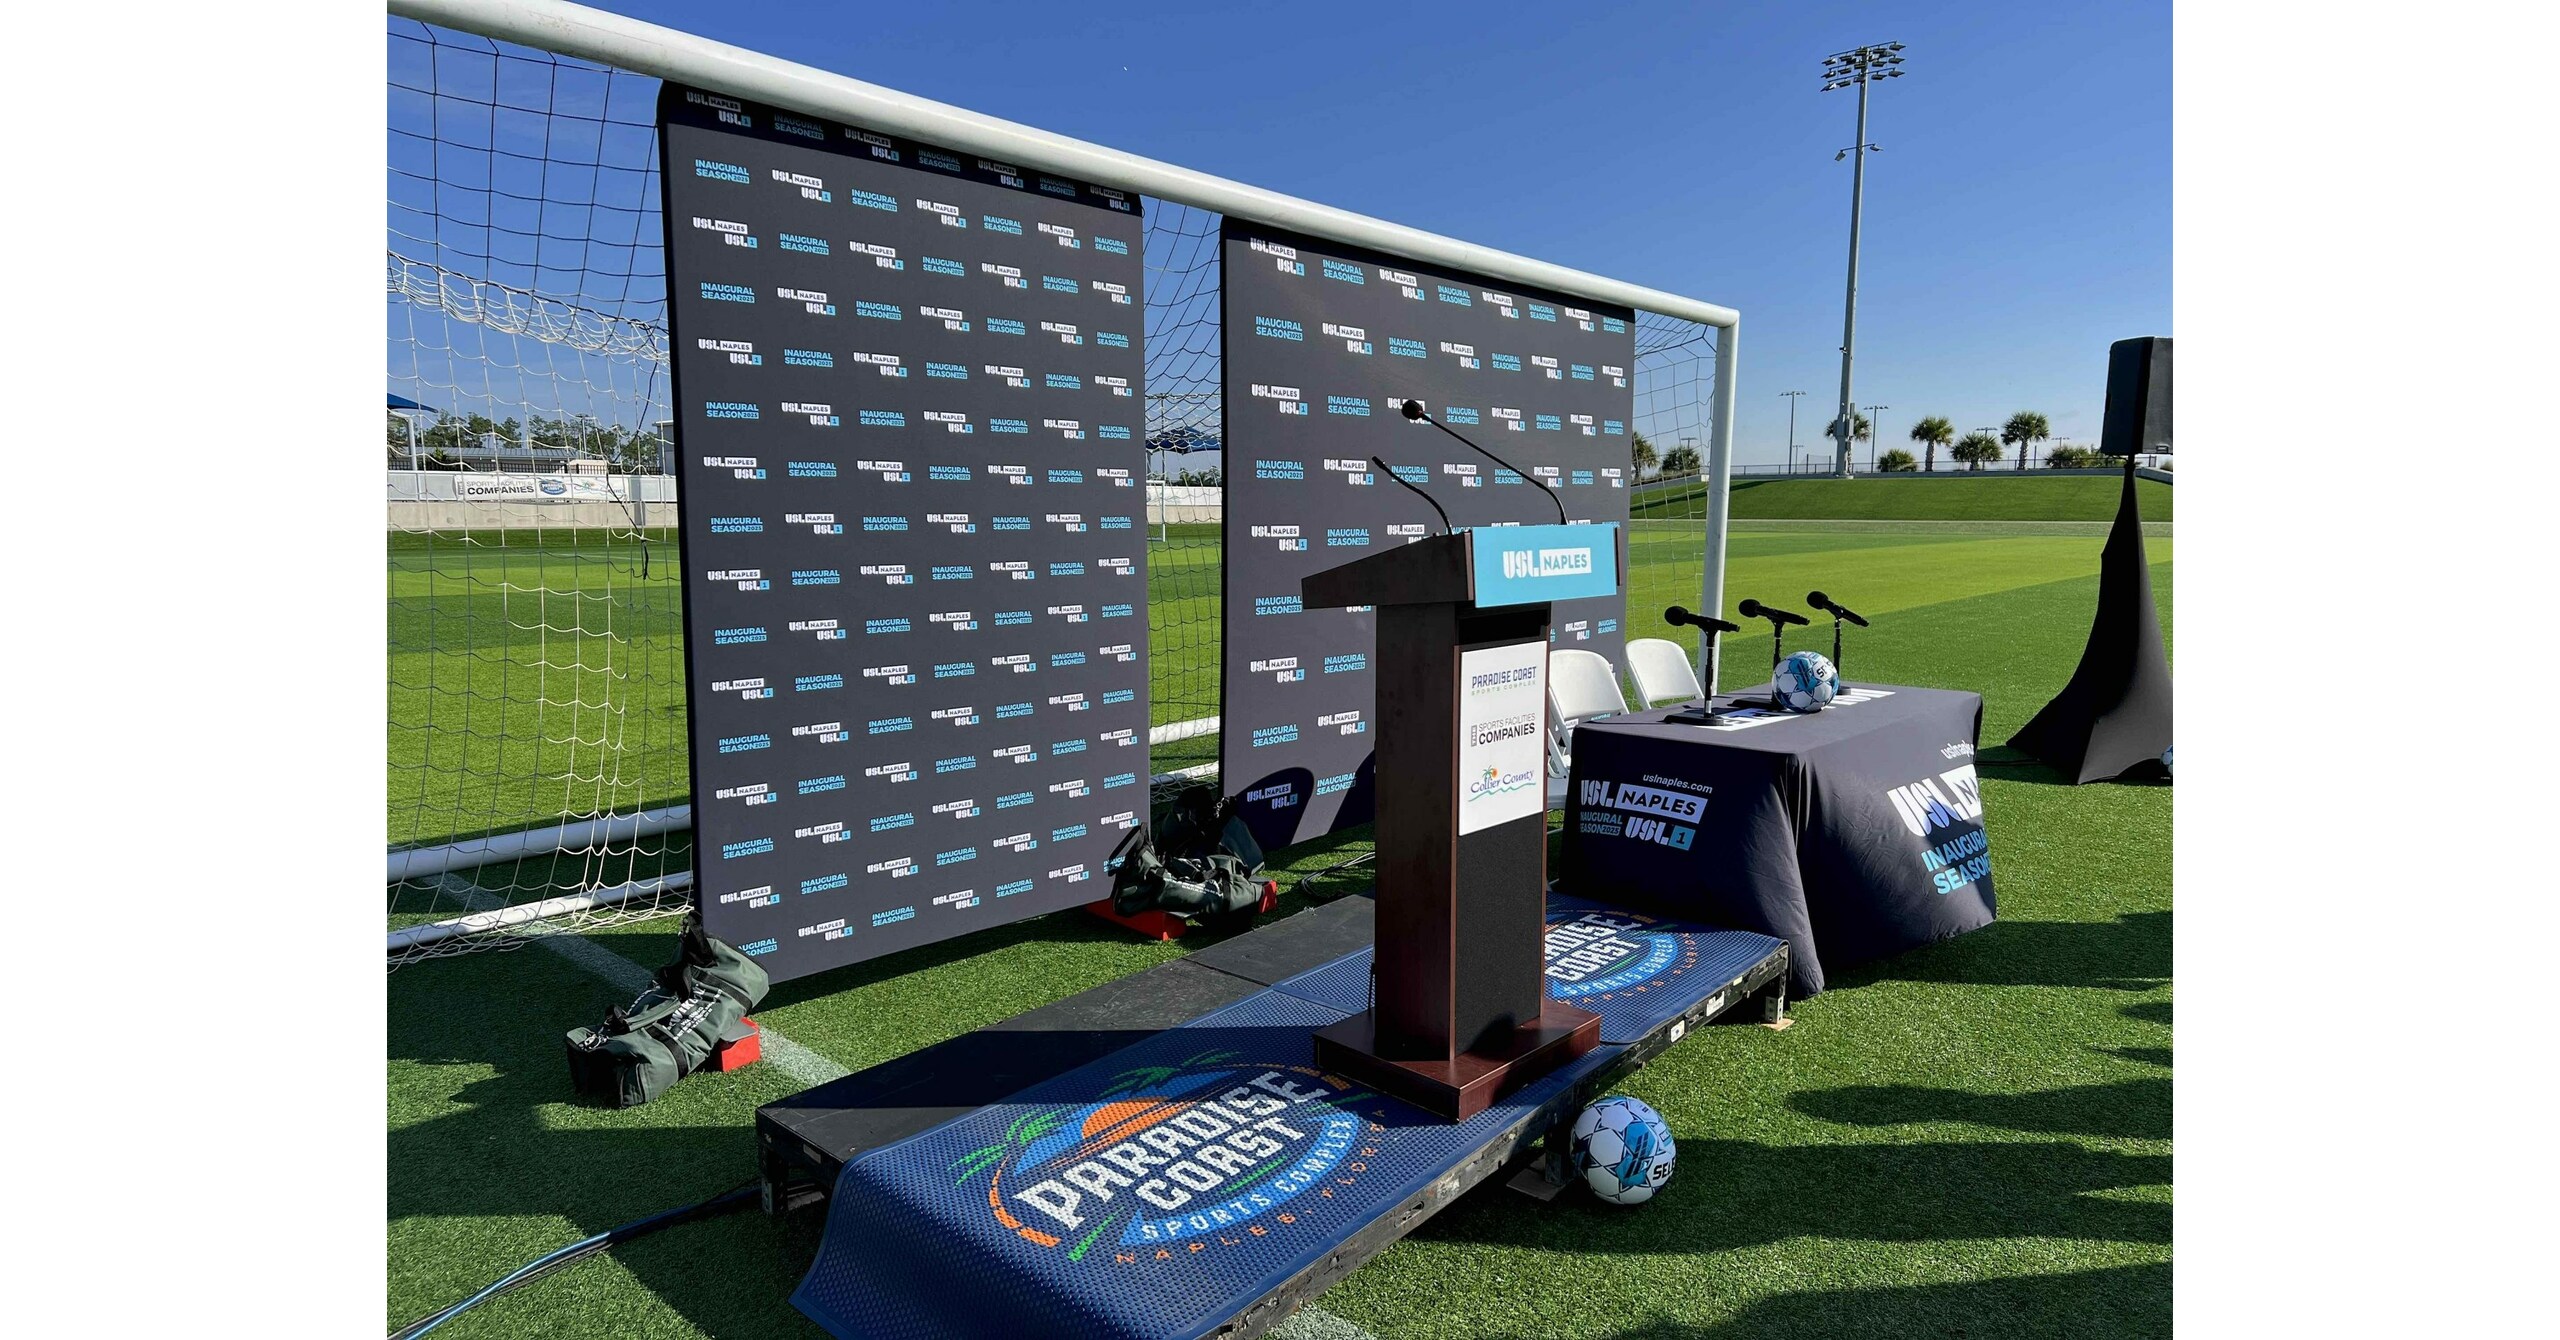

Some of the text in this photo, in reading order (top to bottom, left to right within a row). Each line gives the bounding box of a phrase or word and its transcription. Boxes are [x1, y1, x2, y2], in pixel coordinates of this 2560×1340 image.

[696, 160, 749, 175] INAUGURAL
[794, 176, 820, 187] NAPLES
[717, 222, 746, 233] NAPLES
[780, 233, 829, 247] INAUGURAL
[1271, 245, 1295, 257] NAPLES
[1323, 259, 1363, 276] INAUGURAL
[701, 283, 754, 295] INAUGURAL
[1256, 316, 1302, 331] INAUGURAL
[1341, 328, 1363, 338] NAPLES
[722, 342, 750, 351] NAPLES
[784, 349, 832, 360] INAUGURAL
[1273, 388, 1298, 398] NAPLES
[706, 402, 759, 411] INAUGURAL
[803, 405, 829, 413] NAPLES
[1256, 460, 1303, 470] INAUGURAL
[467, 485, 535, 495] COMPANIES
[1272, 527, 1298, 535] NAPLES
[1503, 550, 1588, 579] USL NAPLES
[792, 570, 840, 578] INAUGURAL
[715, 627, 766, 636] INAUGURAL
[796, 674, 843, 684] INAUGURAL
[1472, 666, 1537, 688] PARADISE COAST
[735, 680, 762, 688] NAPLES
[1479, 713, 1536, 732] SPORTS FACILITIES
[1479, 722, 1535, 745] COMPANIES
[719, 734, 770, 746] INAUGURAL
[798, 775, 845, 787] INAUGURAL
[1470, 769, 1535, 793] Collier County
[1642, 774, 1713, 793] uslnaples.com
[739, 785, 766, 795] NAPLES
[1621, 790, 1697, 816] NAPLES
[1580, 811, 1623, 825] NAUGURAL
[723, 838, 773, 852] INAUGURAL
[1921, 828, 1988, 872] INAUGURA
[743, 887, 769, 898] NAPLES
[1545, 936, 1641, 981] COAST
[1012, 1070, 1331, 1231] PARADISE
[1276, 1119, 1354, 1193] COMPLEX
[1322, 1108, 1386, 1198] FLORIDA
[1136, 1117, 1306, 1211] COAST
[1141, 1193, 1272, 1239] SPORTS
